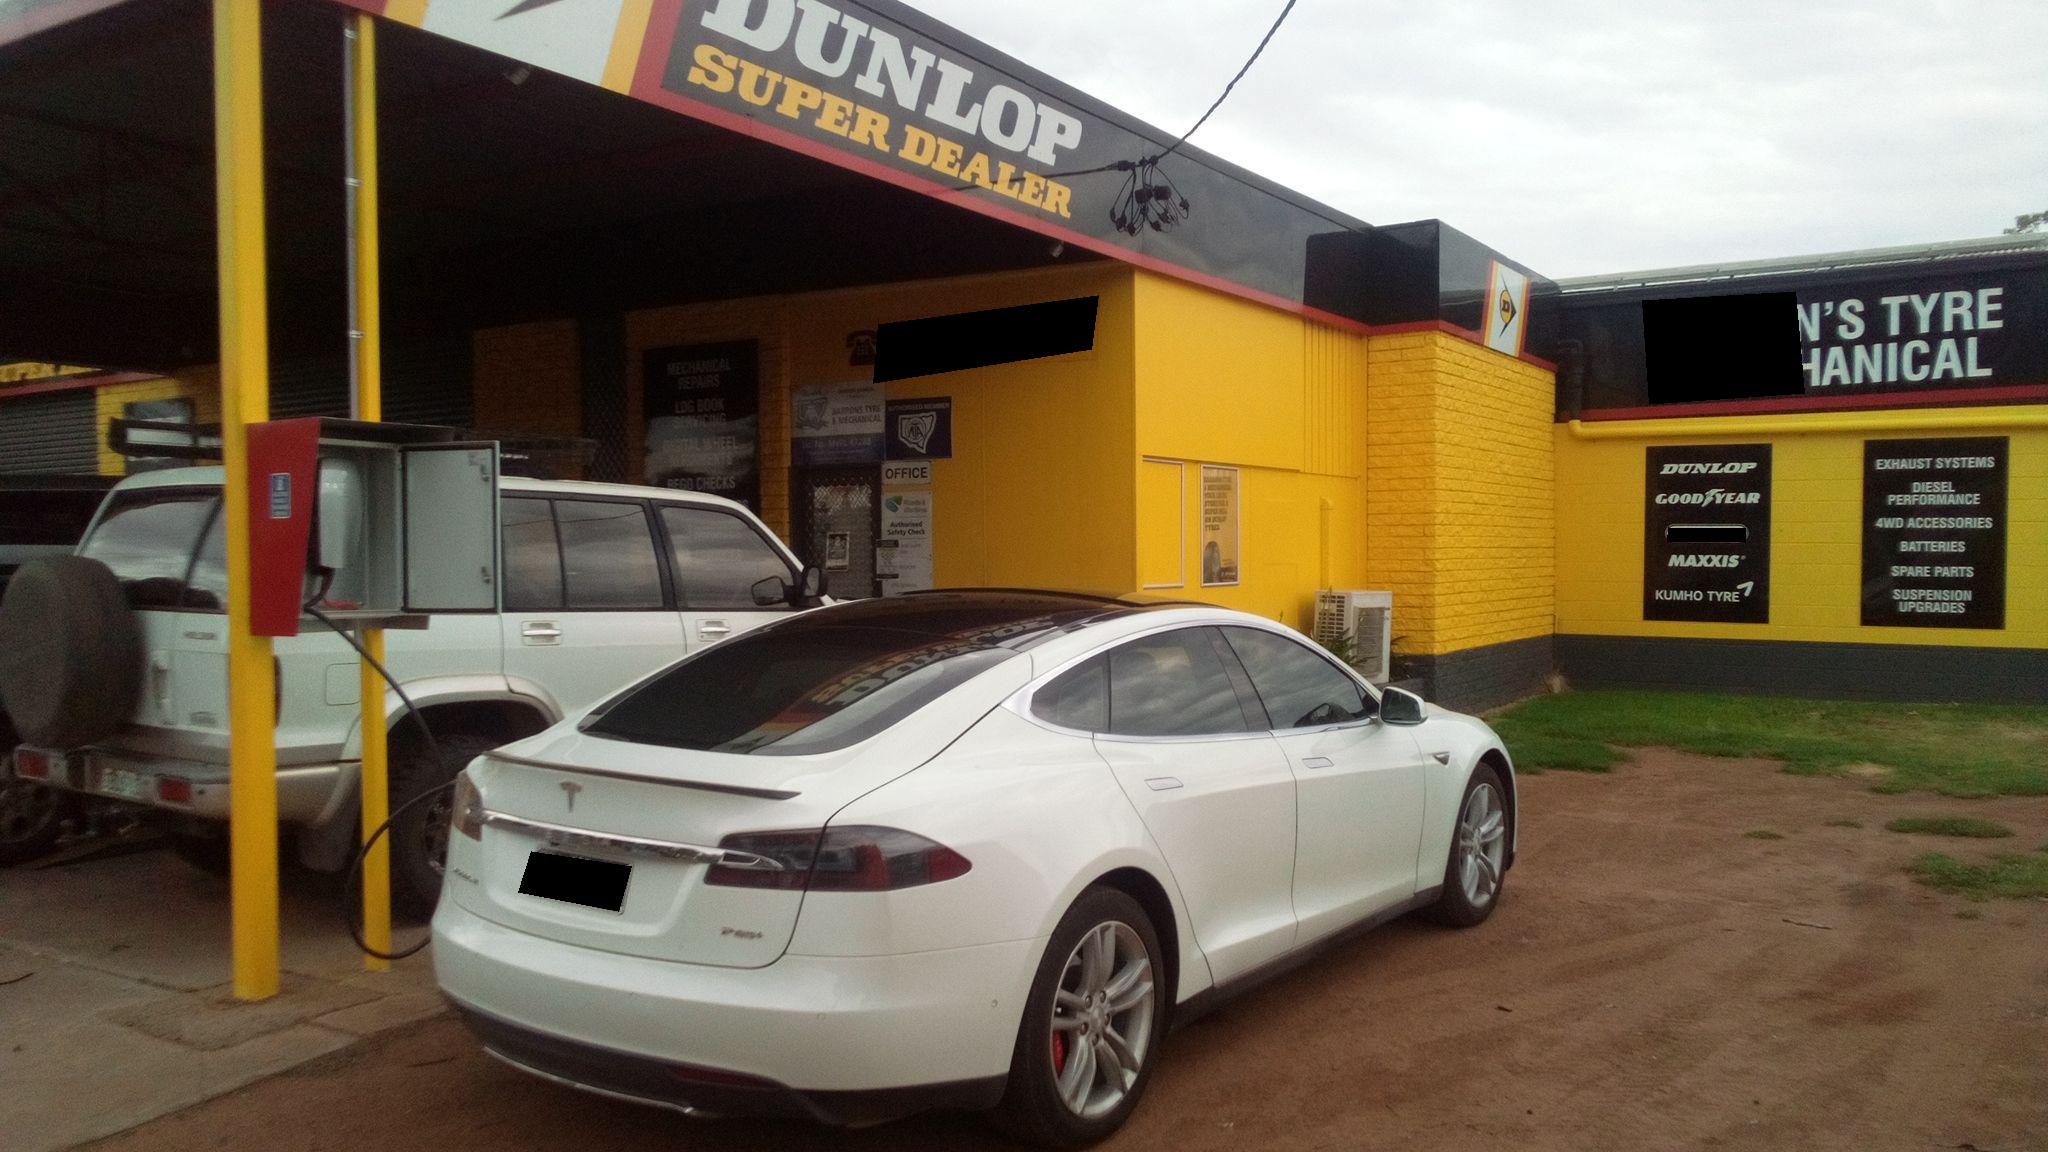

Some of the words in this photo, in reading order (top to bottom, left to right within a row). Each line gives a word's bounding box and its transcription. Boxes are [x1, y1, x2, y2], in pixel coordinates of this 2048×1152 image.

[700, 0, 1082, 166] DUNLOP
[687, 44, 890, 152] SUPER
[899, 124, 1071, 218] DEALER
[1797, 299, 1865, 341] N'S
[1881, 288, 2003, 335] TYRE
[667, 359, 731, 375] MECHANICAL
[1802, 337, 1992, 386] HANICAL
[678, 375, 720, 390] REPAIRS
[675, 401, 694, 413] LOG
[697, 399, 725, 411] BOOK
[1660, 463, 1758, 475] DUNLOP
[1875, 458, 1934, 470] EXHAUST
[1935, 457, 1996, 469] SYSTEMS
[886, 467, 927, 479] OFFICE
[696, 476, 736, 490] CHECKS
[1912, 482, 1956, 493] DIESEL
[1655, 489, 1761, 508] GOODYEAR
[1888, 494, 1981, 506] PERFORMANCE
[1875, 518, 1905, 529] 4WD
[1907, 517, 1994, 529] ACCESSORIES
[1900, 541, 1966, 553] BATTERIES
[1668, 555, 1739, 567] MAXXIS
[1891, 566, 1932, 578] SPARE
[1934, 566, 1975, 578] PARTS
[1655, 590, 1703, 601] KUMHO
[1707, 591, 1740, 602] TYRE
[1893, 589, 1973, 604] SUSPENSION
[1899, 602, 1966, 614] UPGRADES
